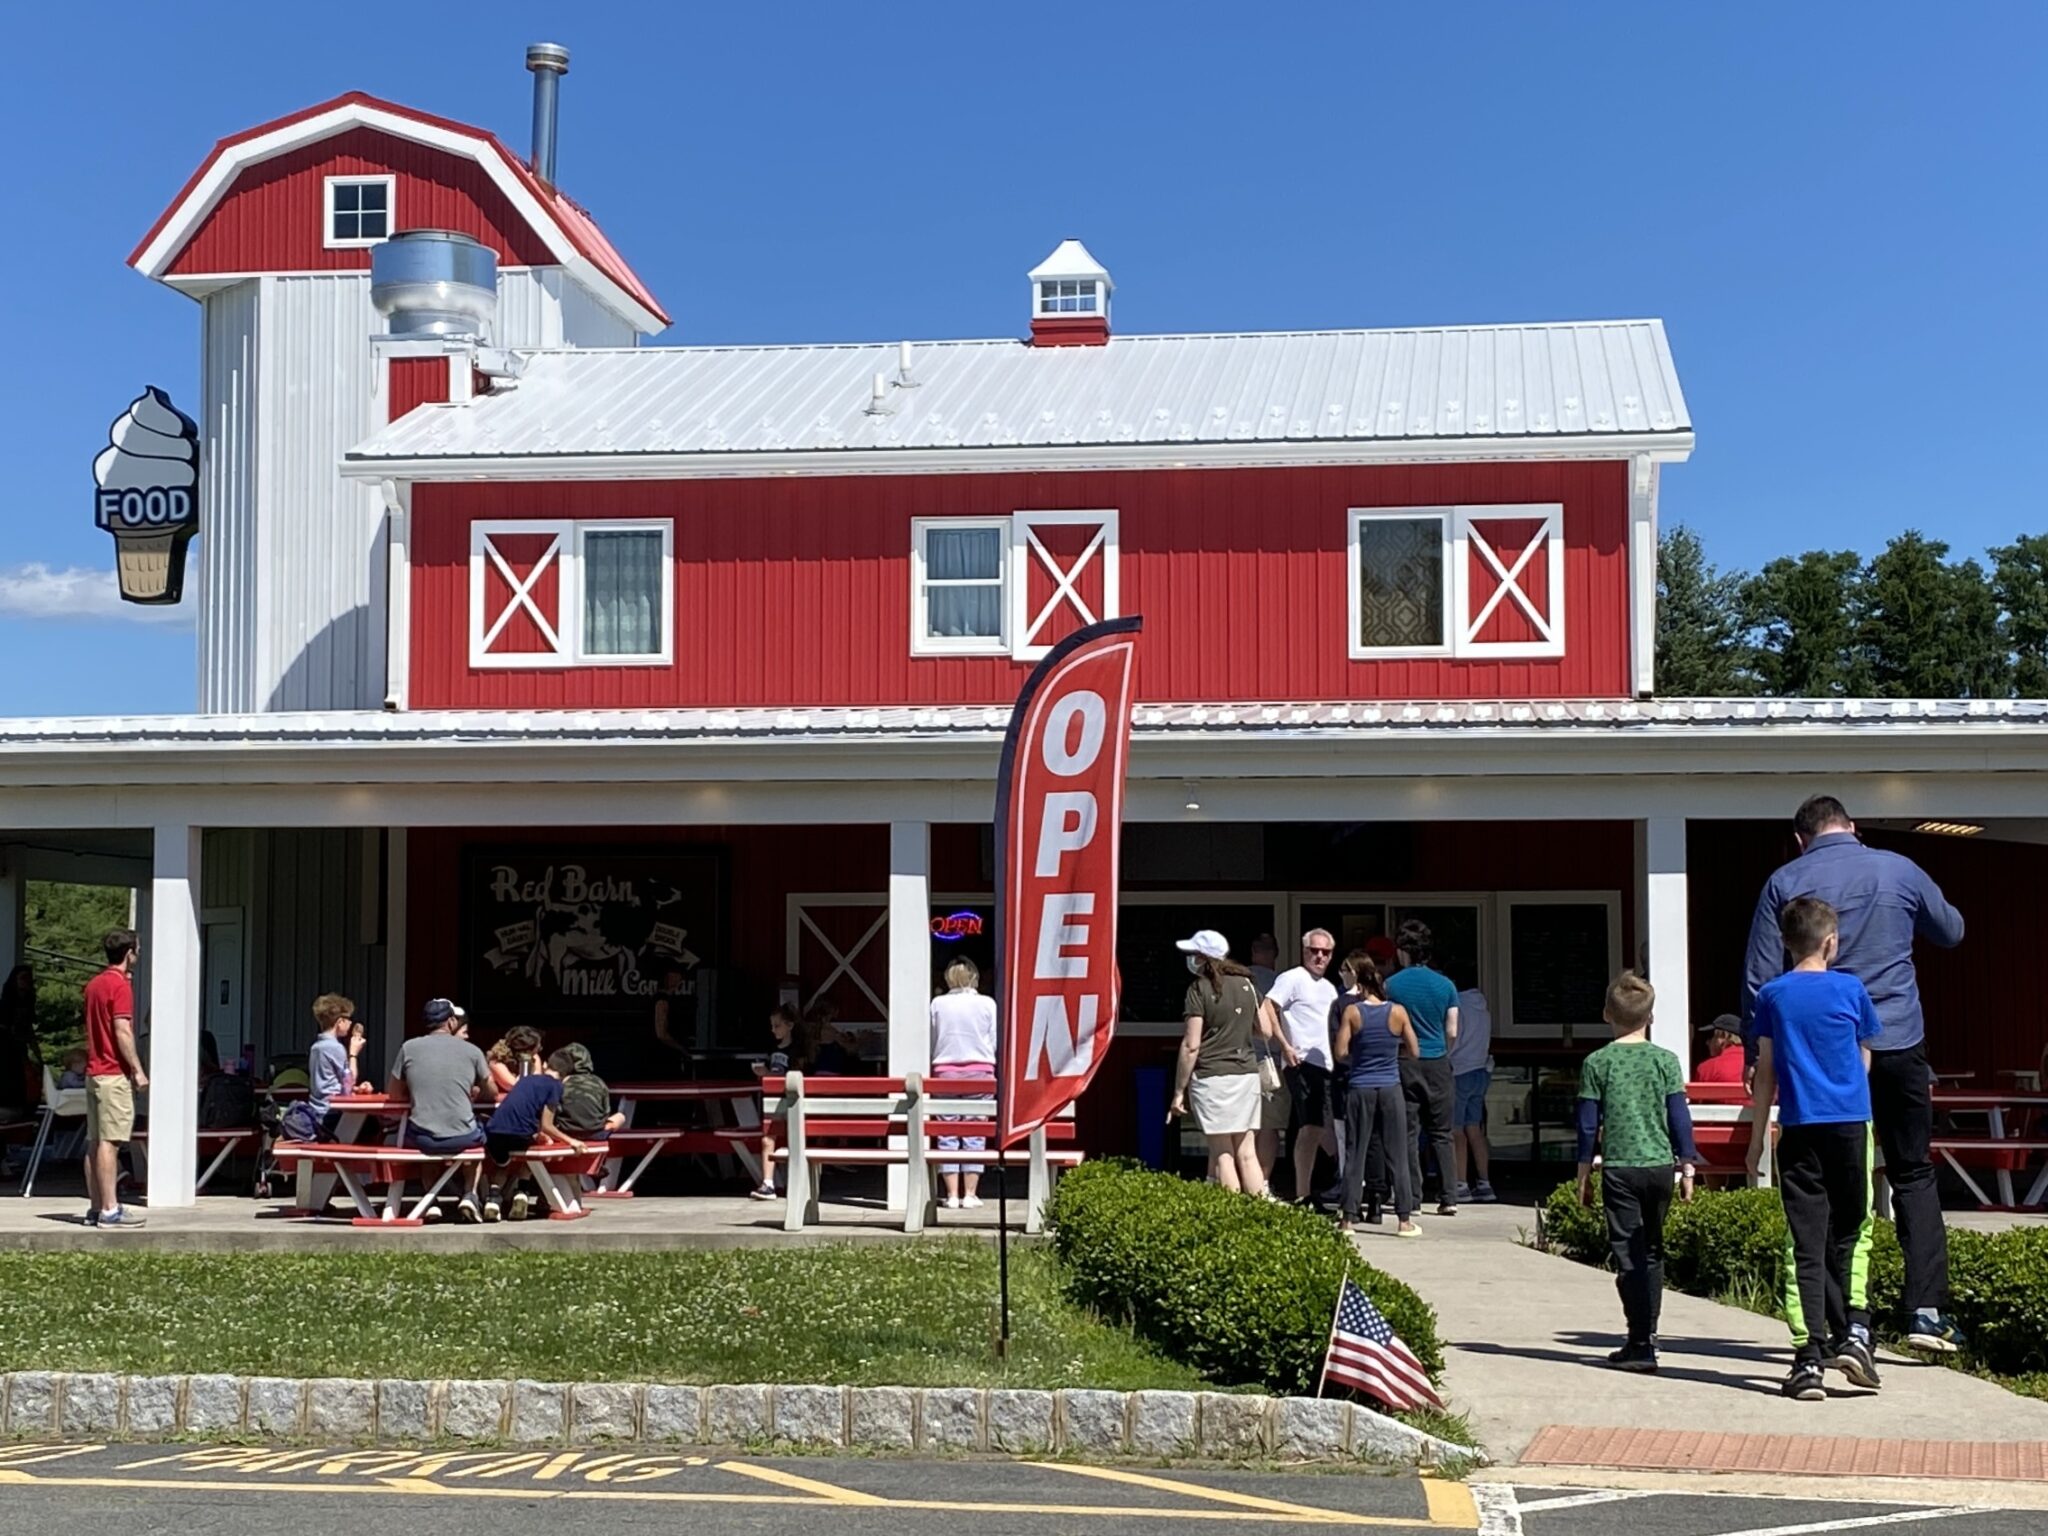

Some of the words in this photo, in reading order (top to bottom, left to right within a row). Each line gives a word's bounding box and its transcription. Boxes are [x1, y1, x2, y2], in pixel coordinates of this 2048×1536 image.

[100, 489, 190, 525] FOOD
[490, 865, 553, 903] Red
[560, 865, 640, 906] Barn
[1025, 690, 1107, 1081] OPEN
[930, 917, 982, 934] OPEN
[562, 969, 616, 995] Milk
[114, 1447, 708, 1482] PARKING
